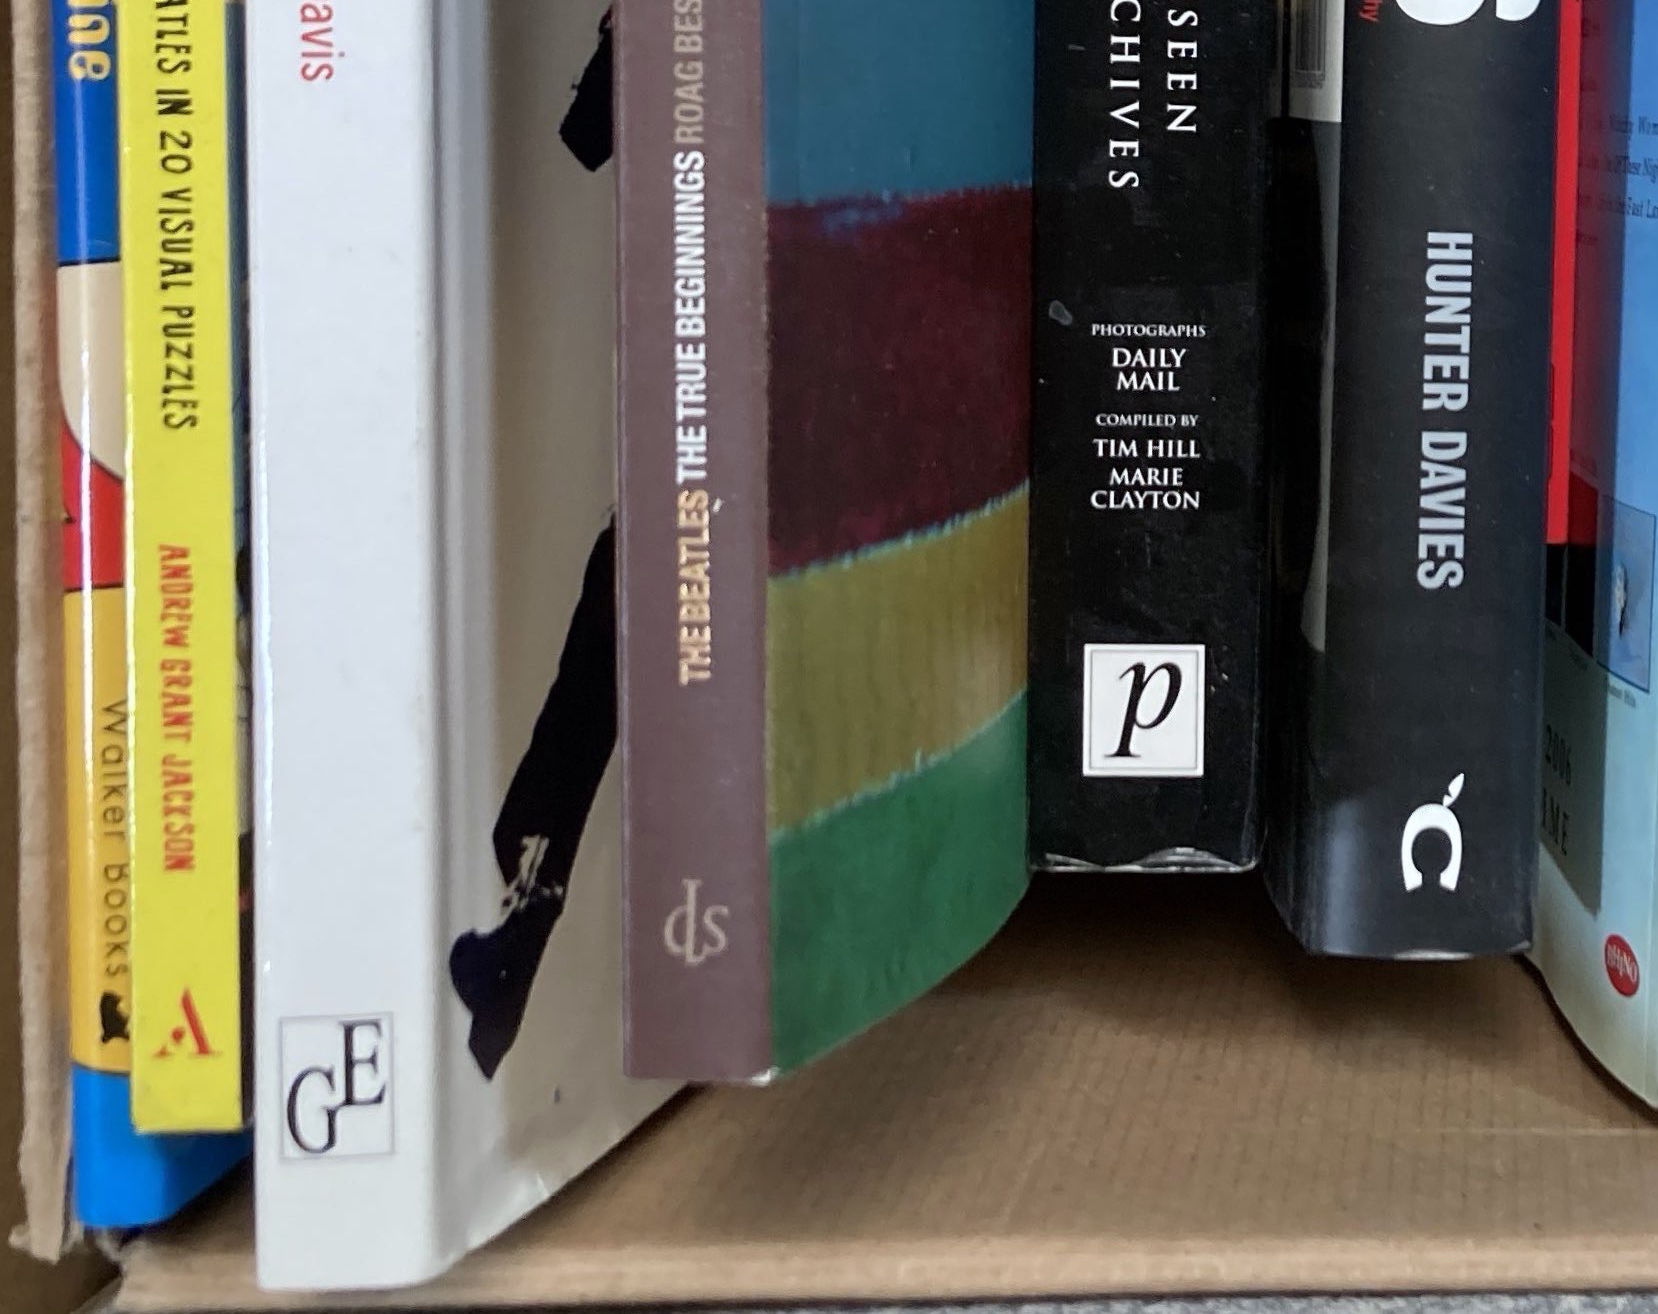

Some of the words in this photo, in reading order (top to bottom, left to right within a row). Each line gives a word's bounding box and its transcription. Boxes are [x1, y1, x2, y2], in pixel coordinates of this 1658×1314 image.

[157, 90, 191, 115] IN
[674, 62, 703, 143] ROAG
[160, 131, 192, 174] 20
[158, 188, 193, 290] VISUAL
[674, 151, 705, 336] BEGINNINGS
[1092, 324, 1205, 337] PHOTOGRAPHS
[1113, 348, 1186, 367] DAILY
[1423, 232, 1473, 410] HUNTER
[162, 306, 197, 429] PUZZLES
[676, 343, 706, 421] TRUE
[1117, 371, 1180, 390] MAIL
[677, 426, 706, 484] THE
[1093, 439, 1138, 457] TIM
[1148, 440, 1200, 457] HILL
[1096, 414, 1176, 427] COMPILED
[1181, 415, 1198, 426] BY
[1091, 491, 1199, 509] CLAYTON
[1110, 468, 1182, 486] MARIE
[1417, 432, 1467, 588] DAVIES
[678, 490, 710, 622] BEATLES
[160, 545, 193, 647] ANDREW
[680, 626, 711, 685] THE
[160, 660, 192, 740] GRANT
[102, 699, 127, 840] Walker
[162, 755, 194, 871] JACKSON
[104, 863, 129, 978] Books
